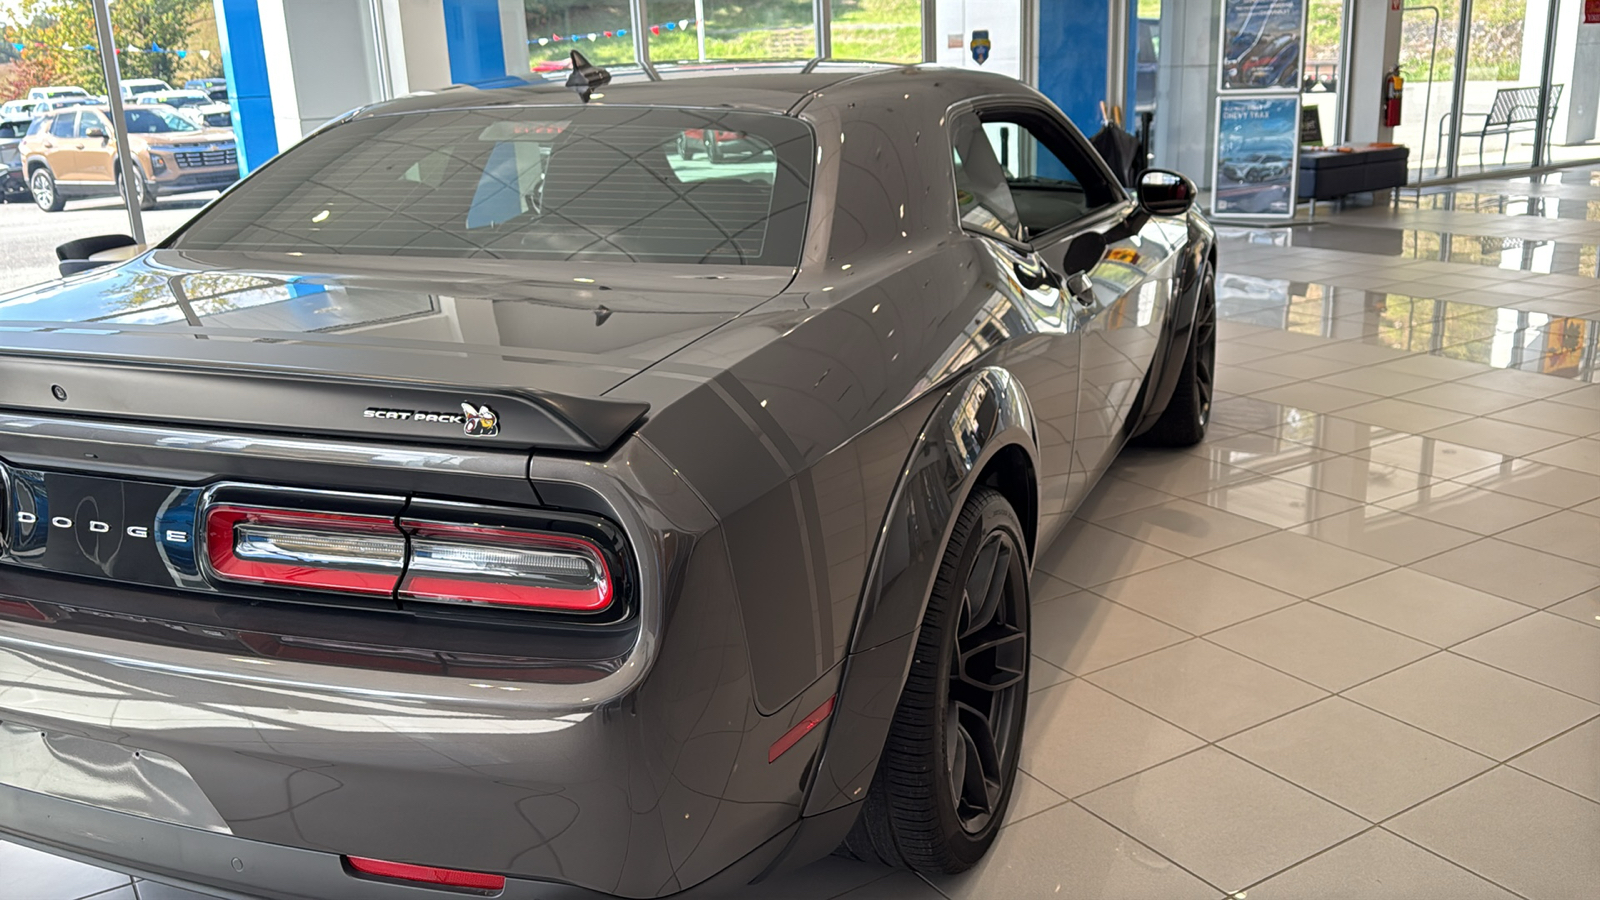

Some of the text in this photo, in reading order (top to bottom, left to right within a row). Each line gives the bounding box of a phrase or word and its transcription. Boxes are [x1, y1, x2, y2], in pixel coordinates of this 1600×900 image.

[363, 409, 462, 424] SCAT PACK
[17, 511, 188, 543] DODGE
